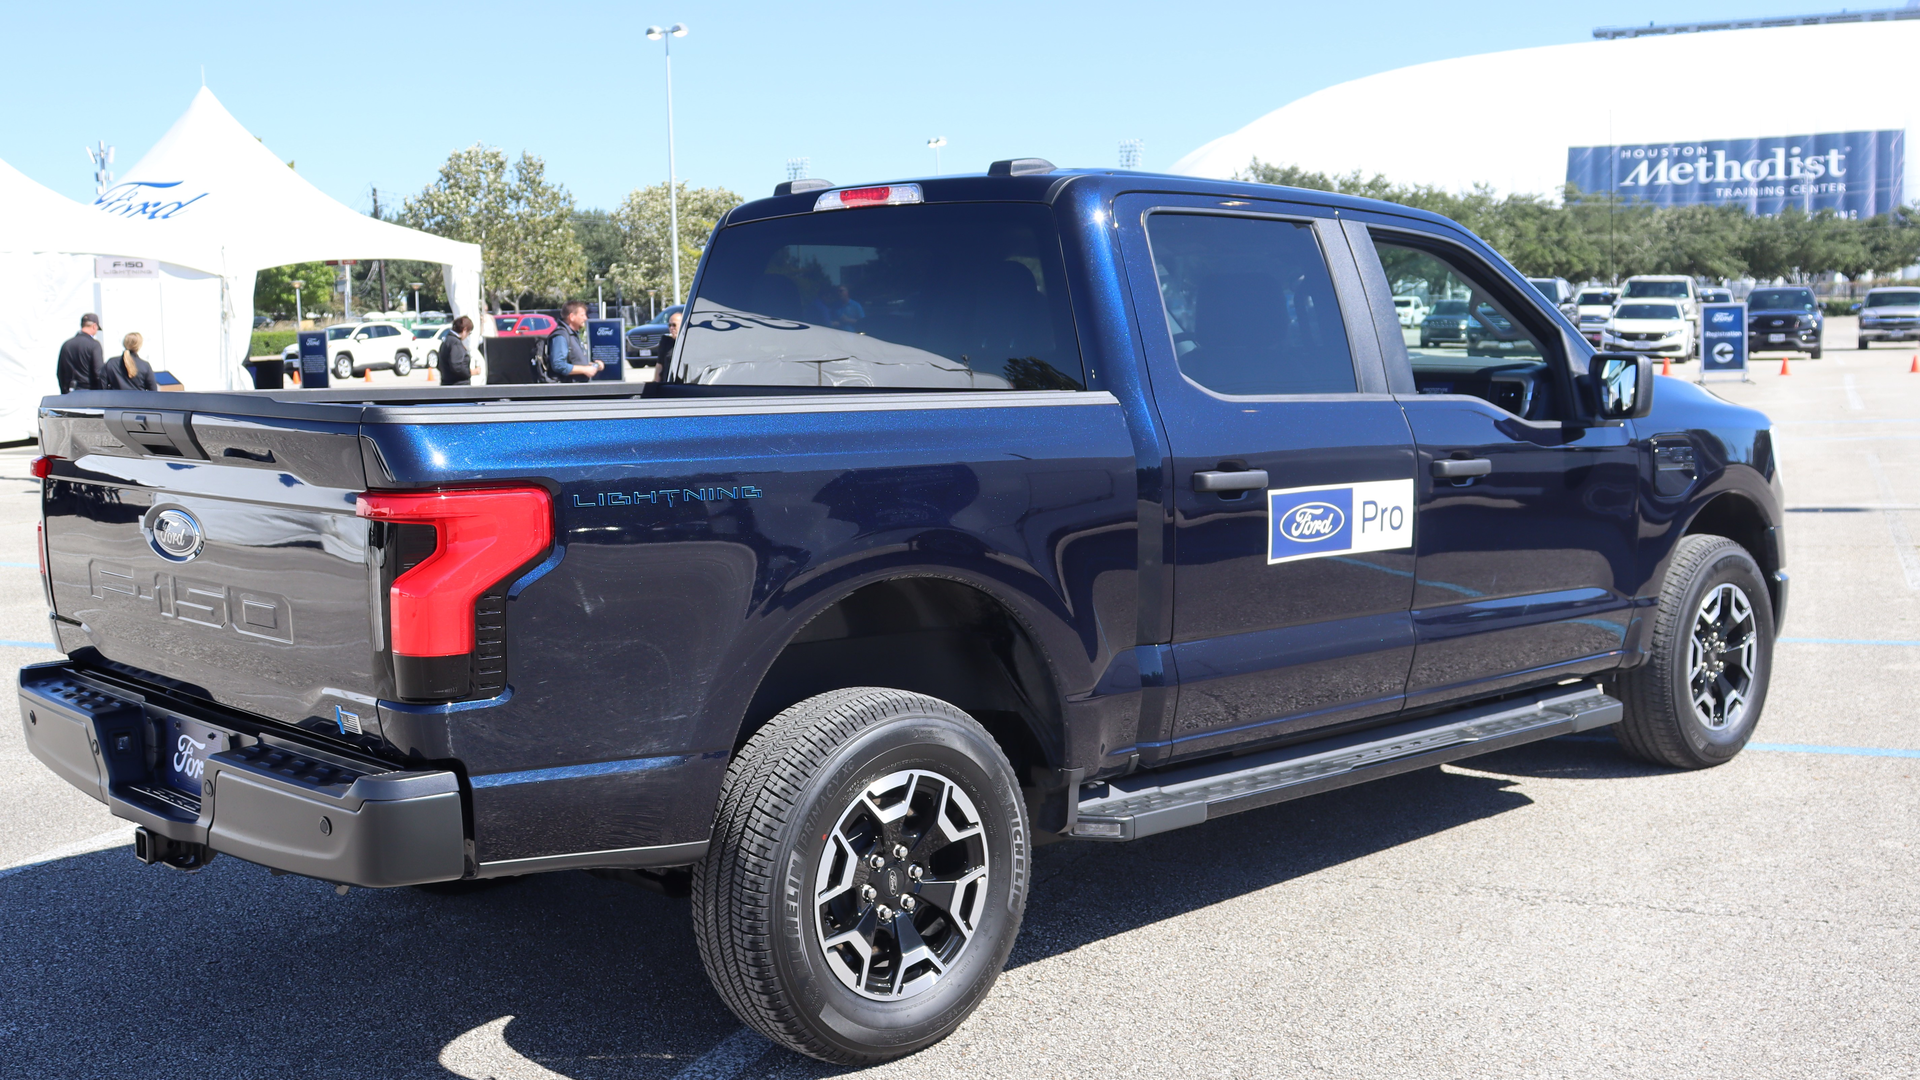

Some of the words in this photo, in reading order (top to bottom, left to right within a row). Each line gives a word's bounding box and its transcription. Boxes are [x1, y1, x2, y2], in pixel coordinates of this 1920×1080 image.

[1621, 146, 1708, 159] HOUSTON
[1619, 147, 1847, 187] Methodist
[94, 180, 210, 220] Ford
[1716, 186, 1785, 198] TRAINING
[1790, 182, 1847, 195] CENTER
[113, 261, 144, 269] F-150
[597, 326, 614, 336] Ford
[1712, 312, 1734, 323] Ford
[1705, 331, 1742, 339] Registration
[573, 485, 763, 508] LIGHTNING
[1291, 507, 1334, 537] Ford
[1361, 500, 1404, 534] Pro
[159, 519, 185, 546] Ford
[88, 558, 294, 645] F-150
[173, 734, 206, 779] For
[800, 773, 841, 845] PRIMACY
[1006, 801, 1025, 910] MICHELIN
